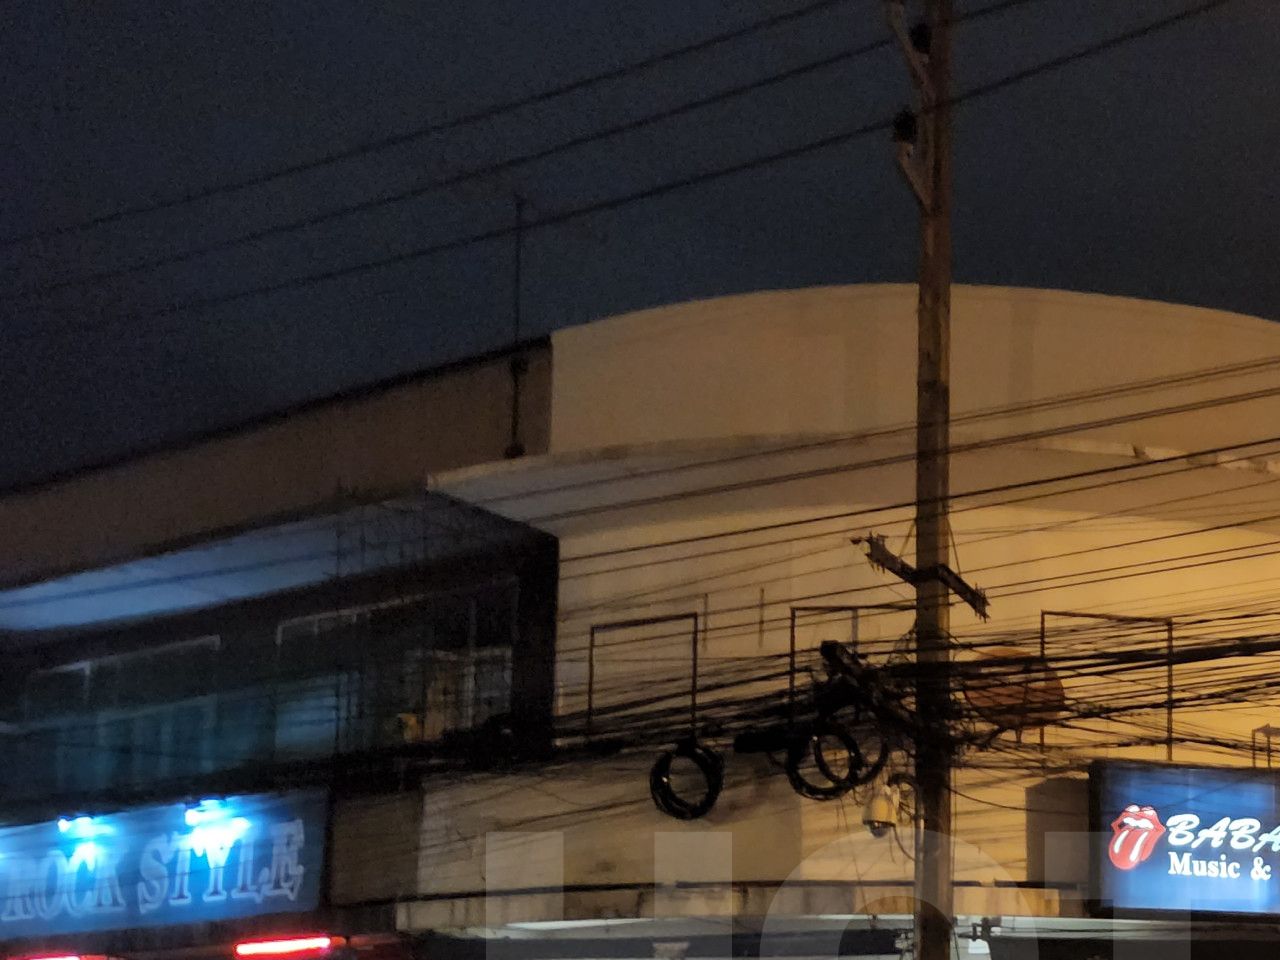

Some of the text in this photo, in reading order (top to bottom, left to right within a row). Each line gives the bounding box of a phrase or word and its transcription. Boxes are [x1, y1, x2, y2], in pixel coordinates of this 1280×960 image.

[137, 819, 304, 914] STYLE
[1168, 852, 1241, 879] Music
[1250, 857, 1271, 880] &
